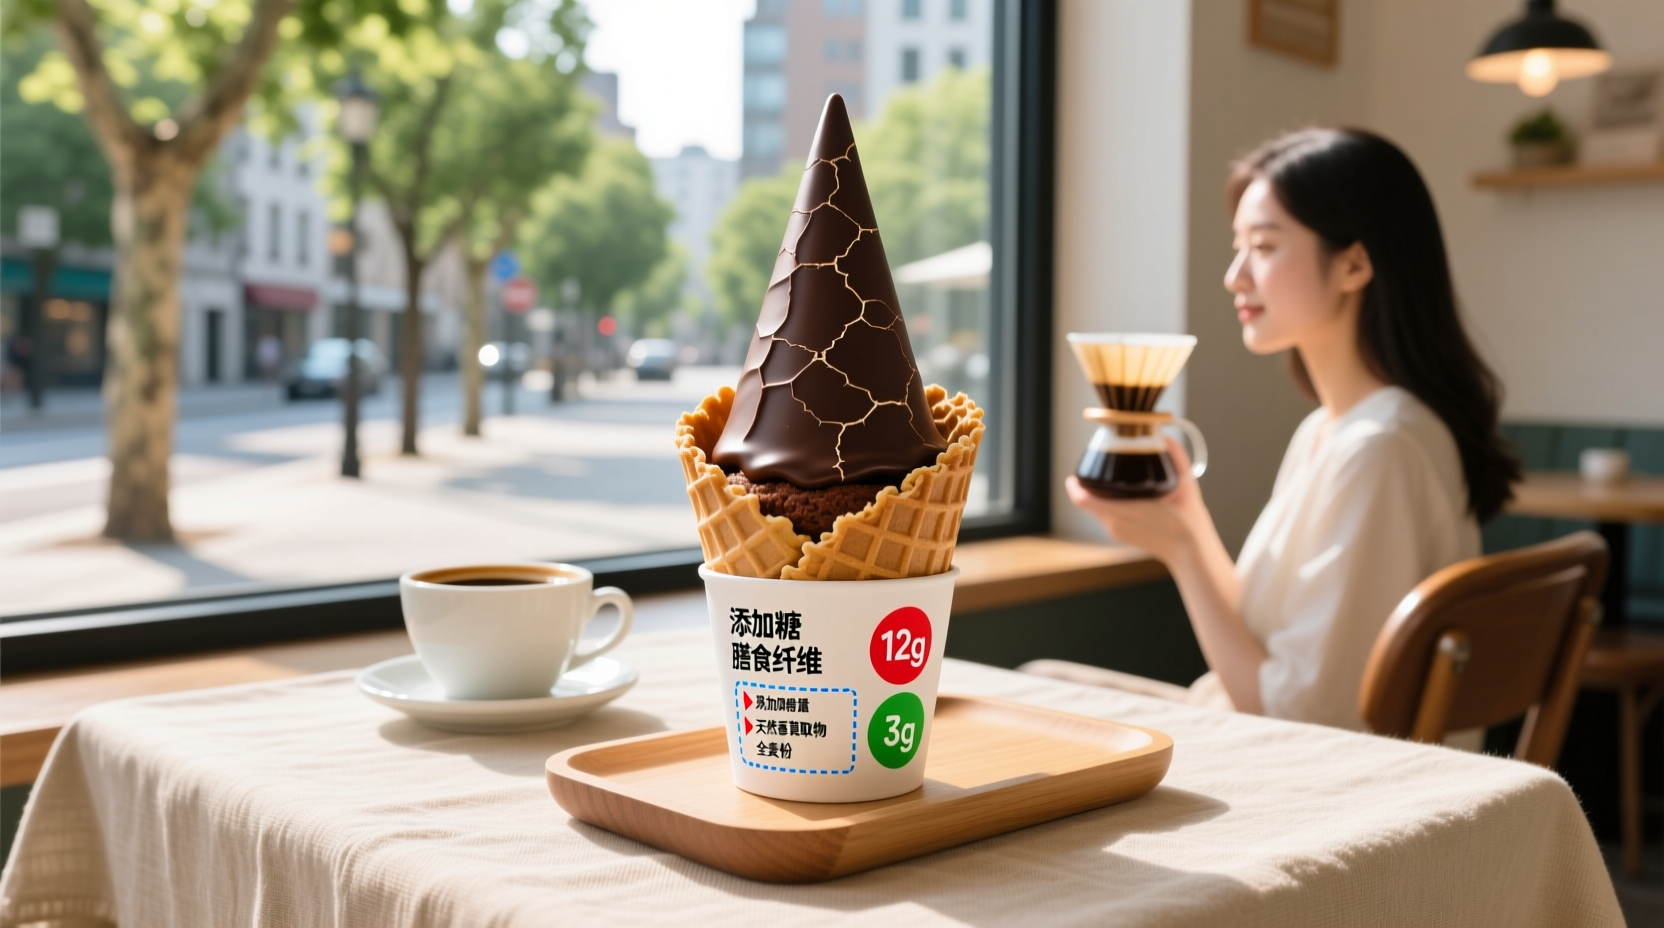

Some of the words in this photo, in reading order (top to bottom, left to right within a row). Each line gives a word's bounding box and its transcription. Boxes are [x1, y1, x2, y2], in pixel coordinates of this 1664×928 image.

[730, 607, 802, 640] 添加糖
[732, 641, 822, 675] 膳食纤维
[881, 628, 926, 668] 12g
[884, 714, 916, 753] 3g
